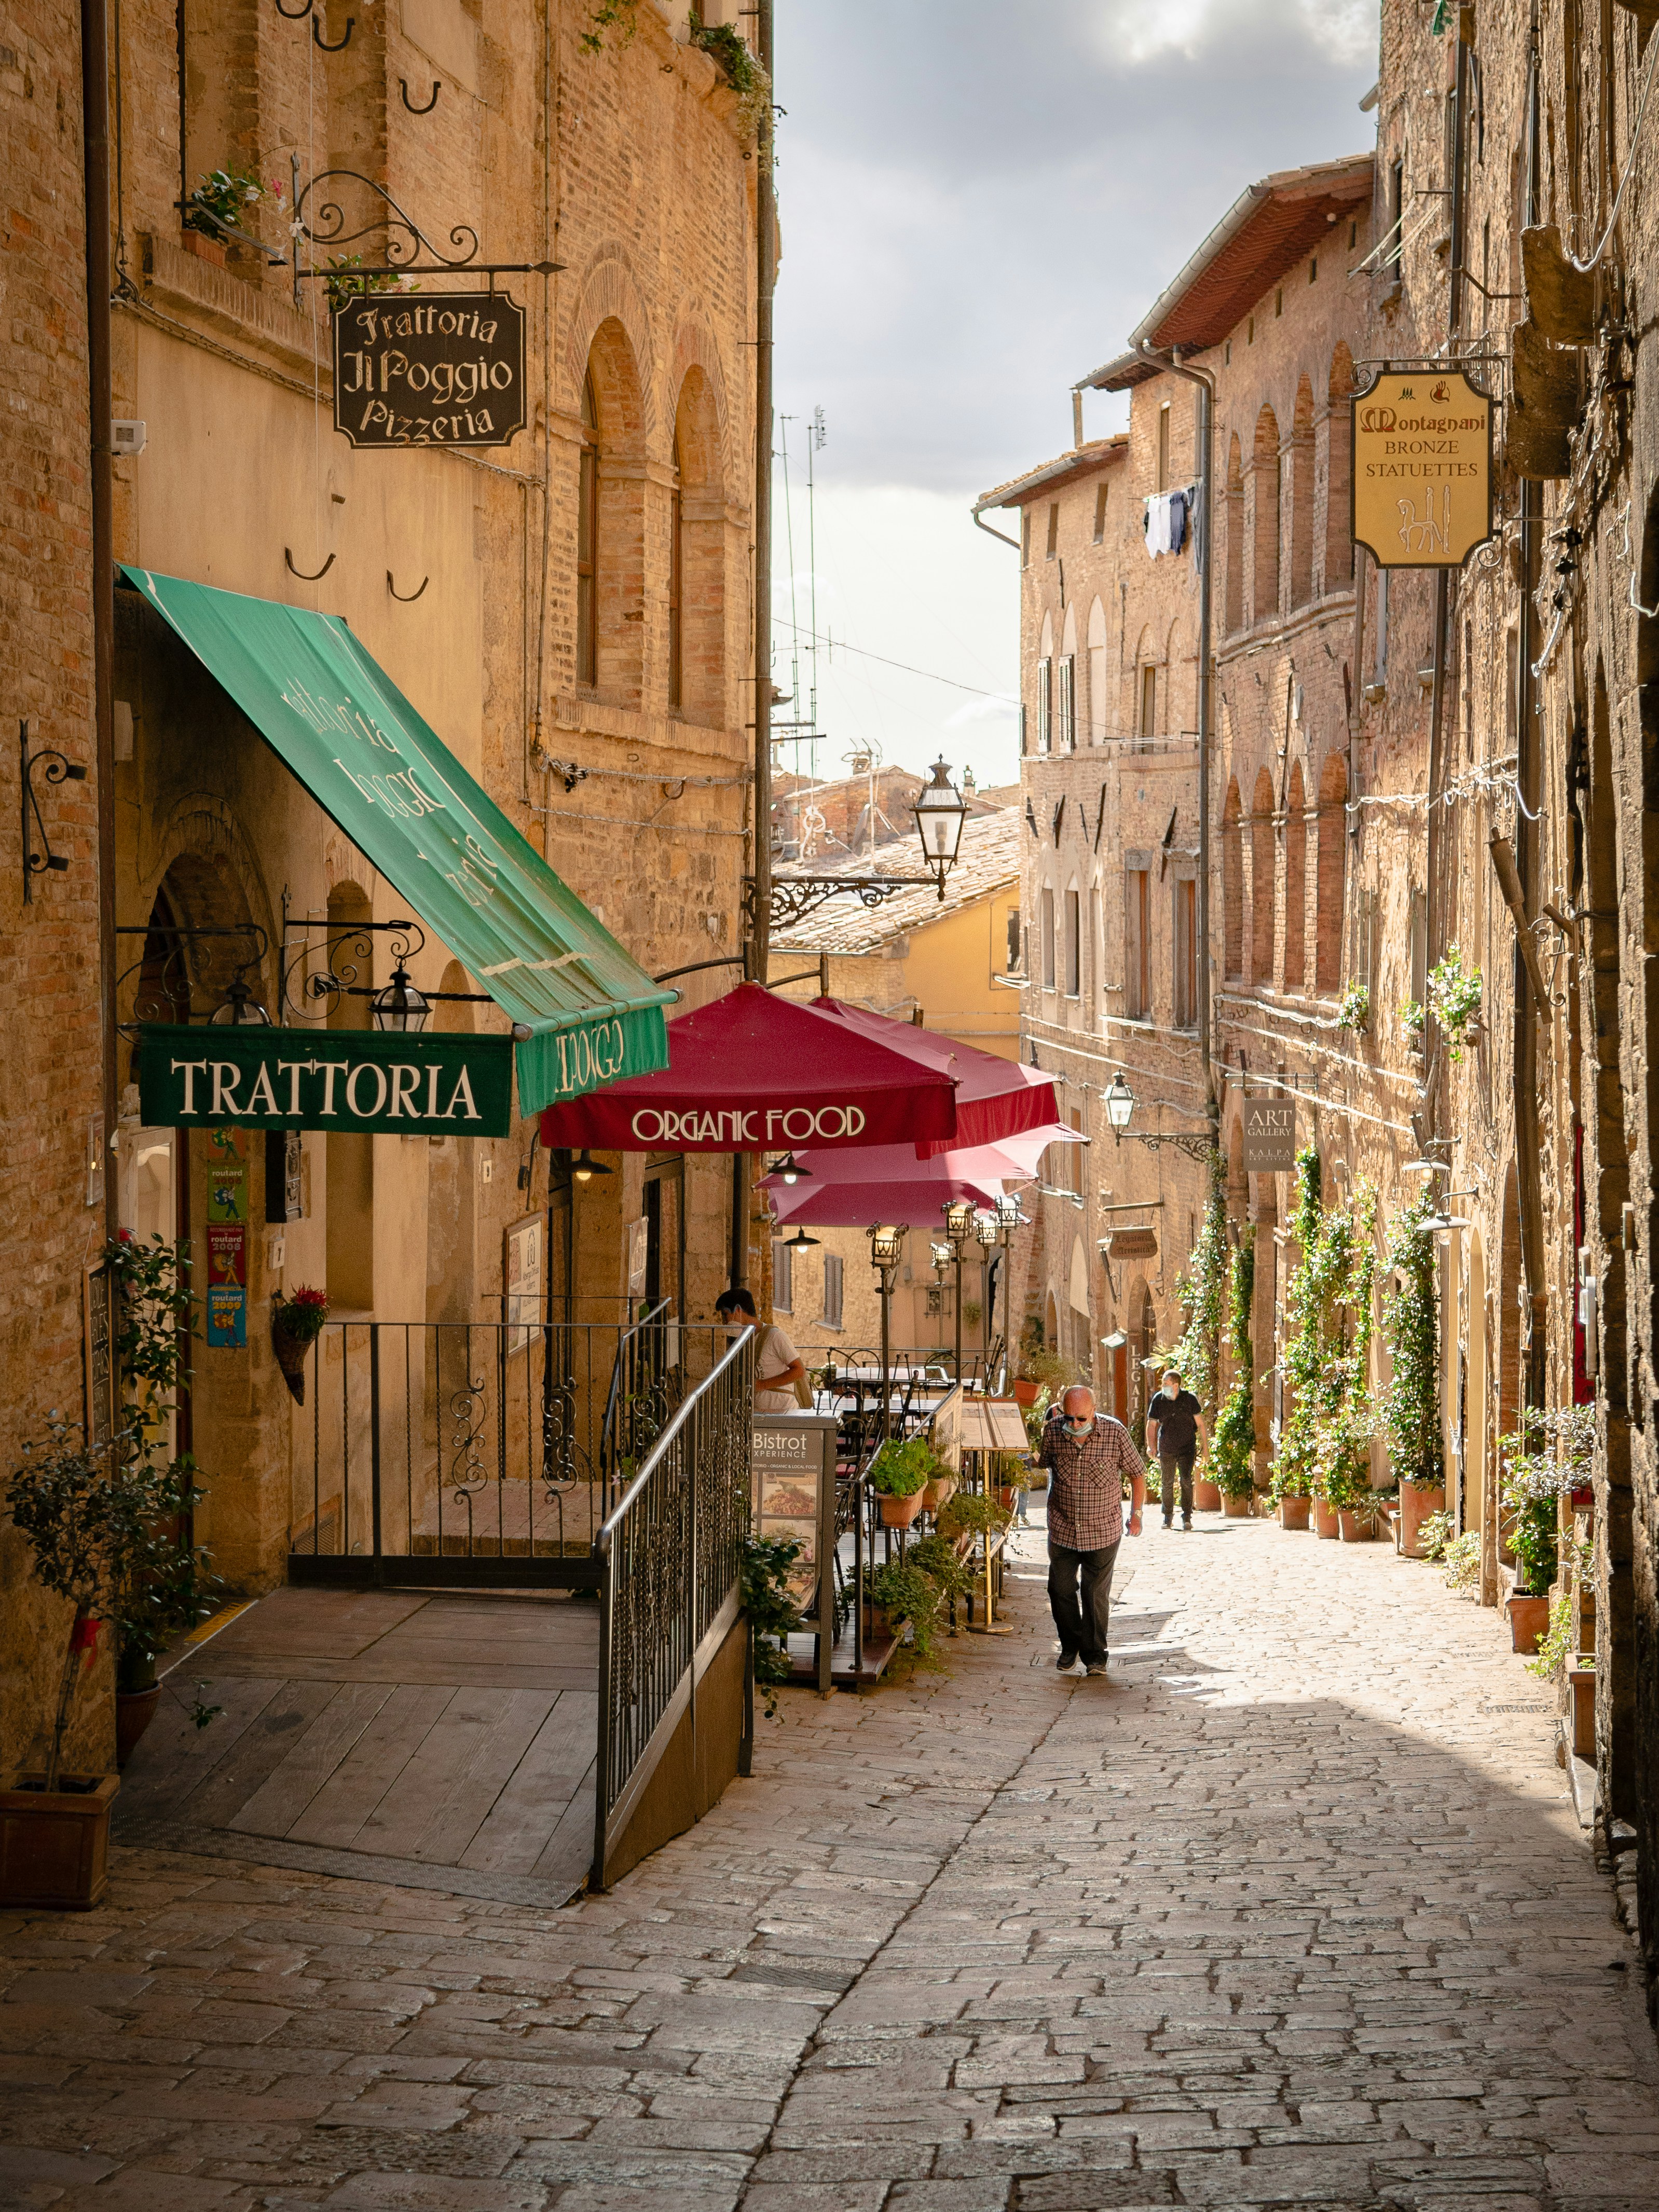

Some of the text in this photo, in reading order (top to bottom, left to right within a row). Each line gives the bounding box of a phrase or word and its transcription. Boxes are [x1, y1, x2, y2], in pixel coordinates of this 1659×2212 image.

[357, 305, 498, 346] Trattoria
[380, 349, 513, 404] Poggio
[360, 400, 495, 446] Pizzeria
[1360, 407, 1485, 434] Montagnani
[1385, 441, 1459, 455] BRONZE
[1366, 463, 1478, 477] STATUETTES
[170, 1057, 483, 1120] TRATTORIA
[632, 1105, 866, 1142] ORGANIC FOOD
[1249, 1110, 1292, 1126] ART
[1248, 1128, 1291, 1136] GALLERY
[213, 1301, 241, 1310] 2009
[753, 1433, 806, 1450] Bistrot
